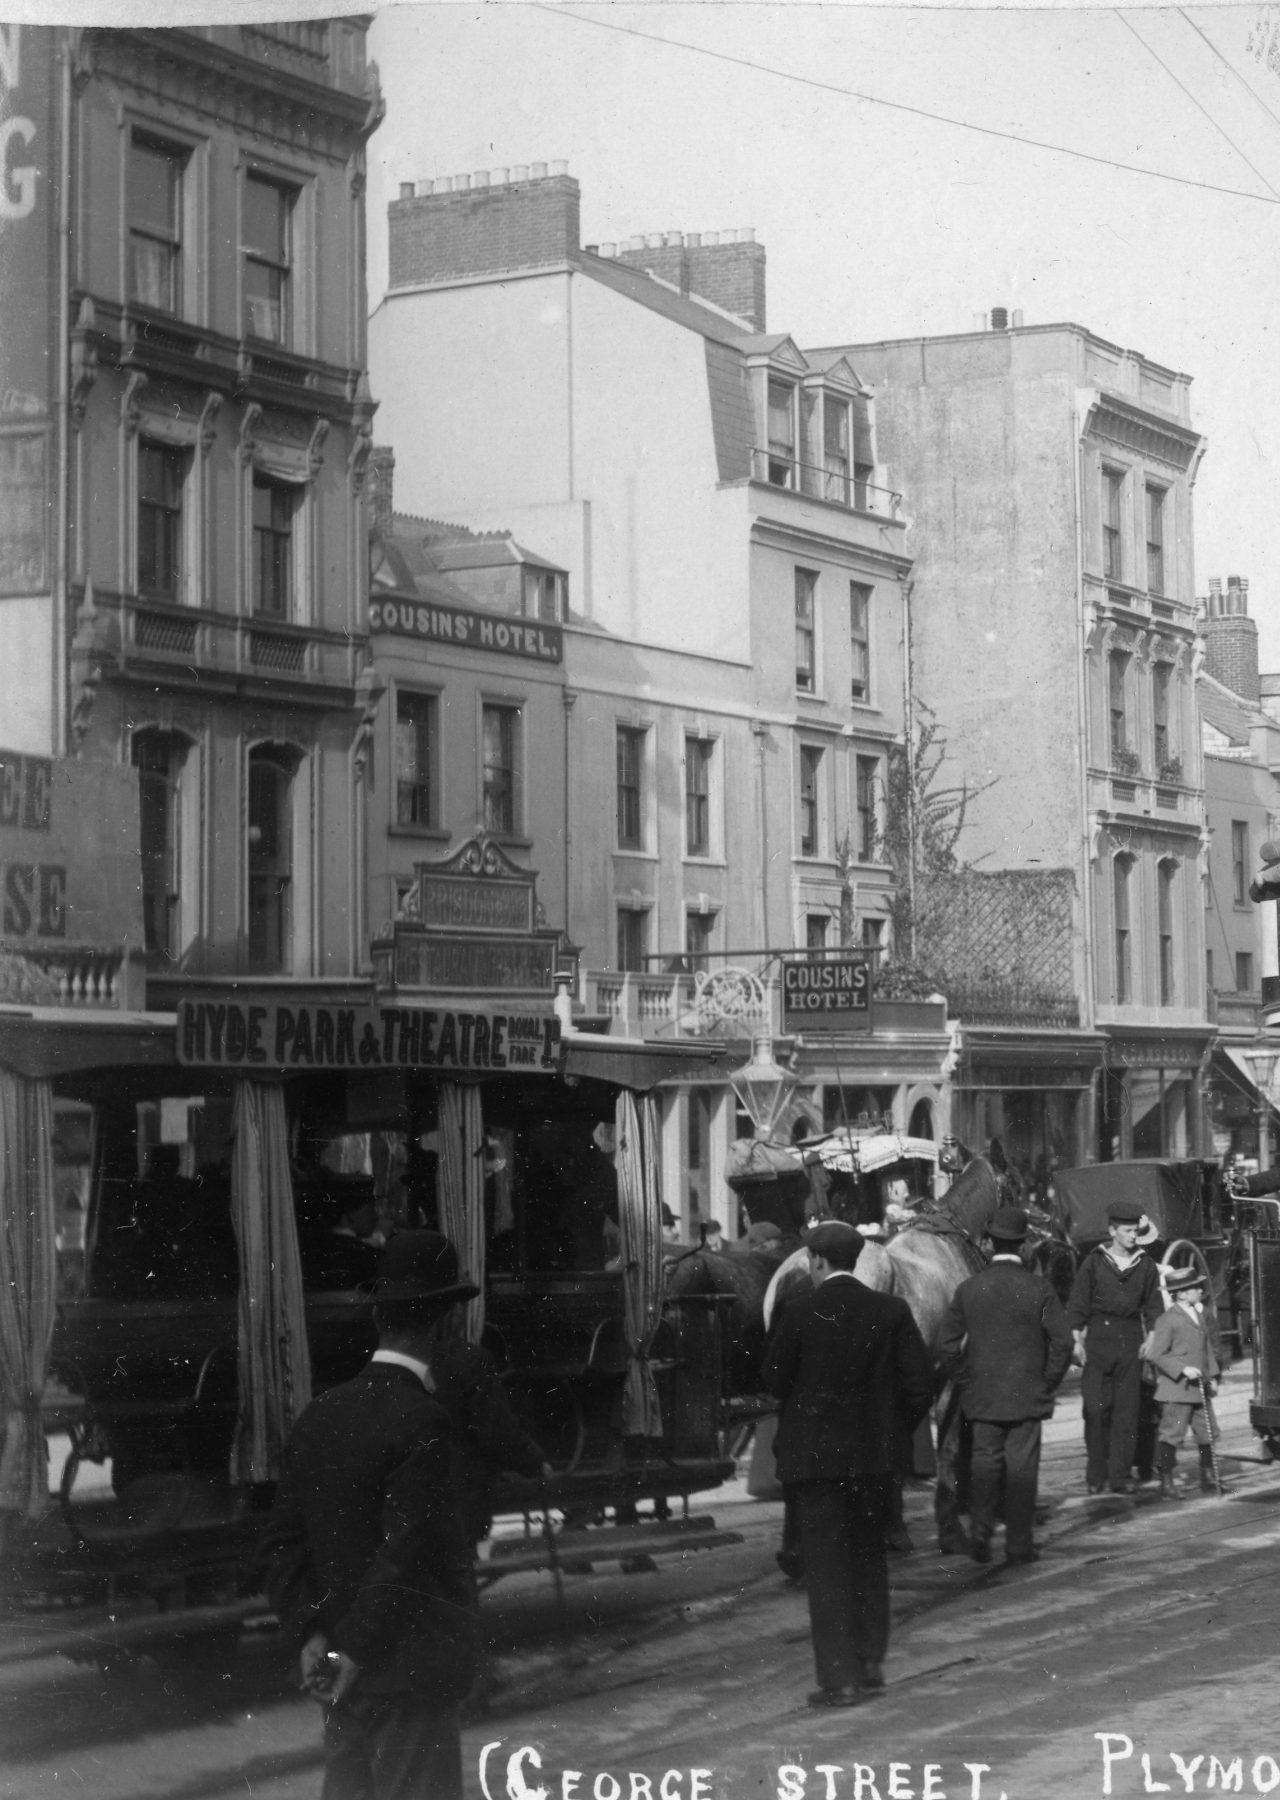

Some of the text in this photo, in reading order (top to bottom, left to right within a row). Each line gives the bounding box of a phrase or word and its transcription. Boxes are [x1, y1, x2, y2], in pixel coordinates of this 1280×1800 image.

[370, 602, 558, 657] COUSINS' HOTEL.
[790, 991, 866, 1009] HOTEL
[183, 1003, 507, 1068] HYDE PARK & THEATRE
